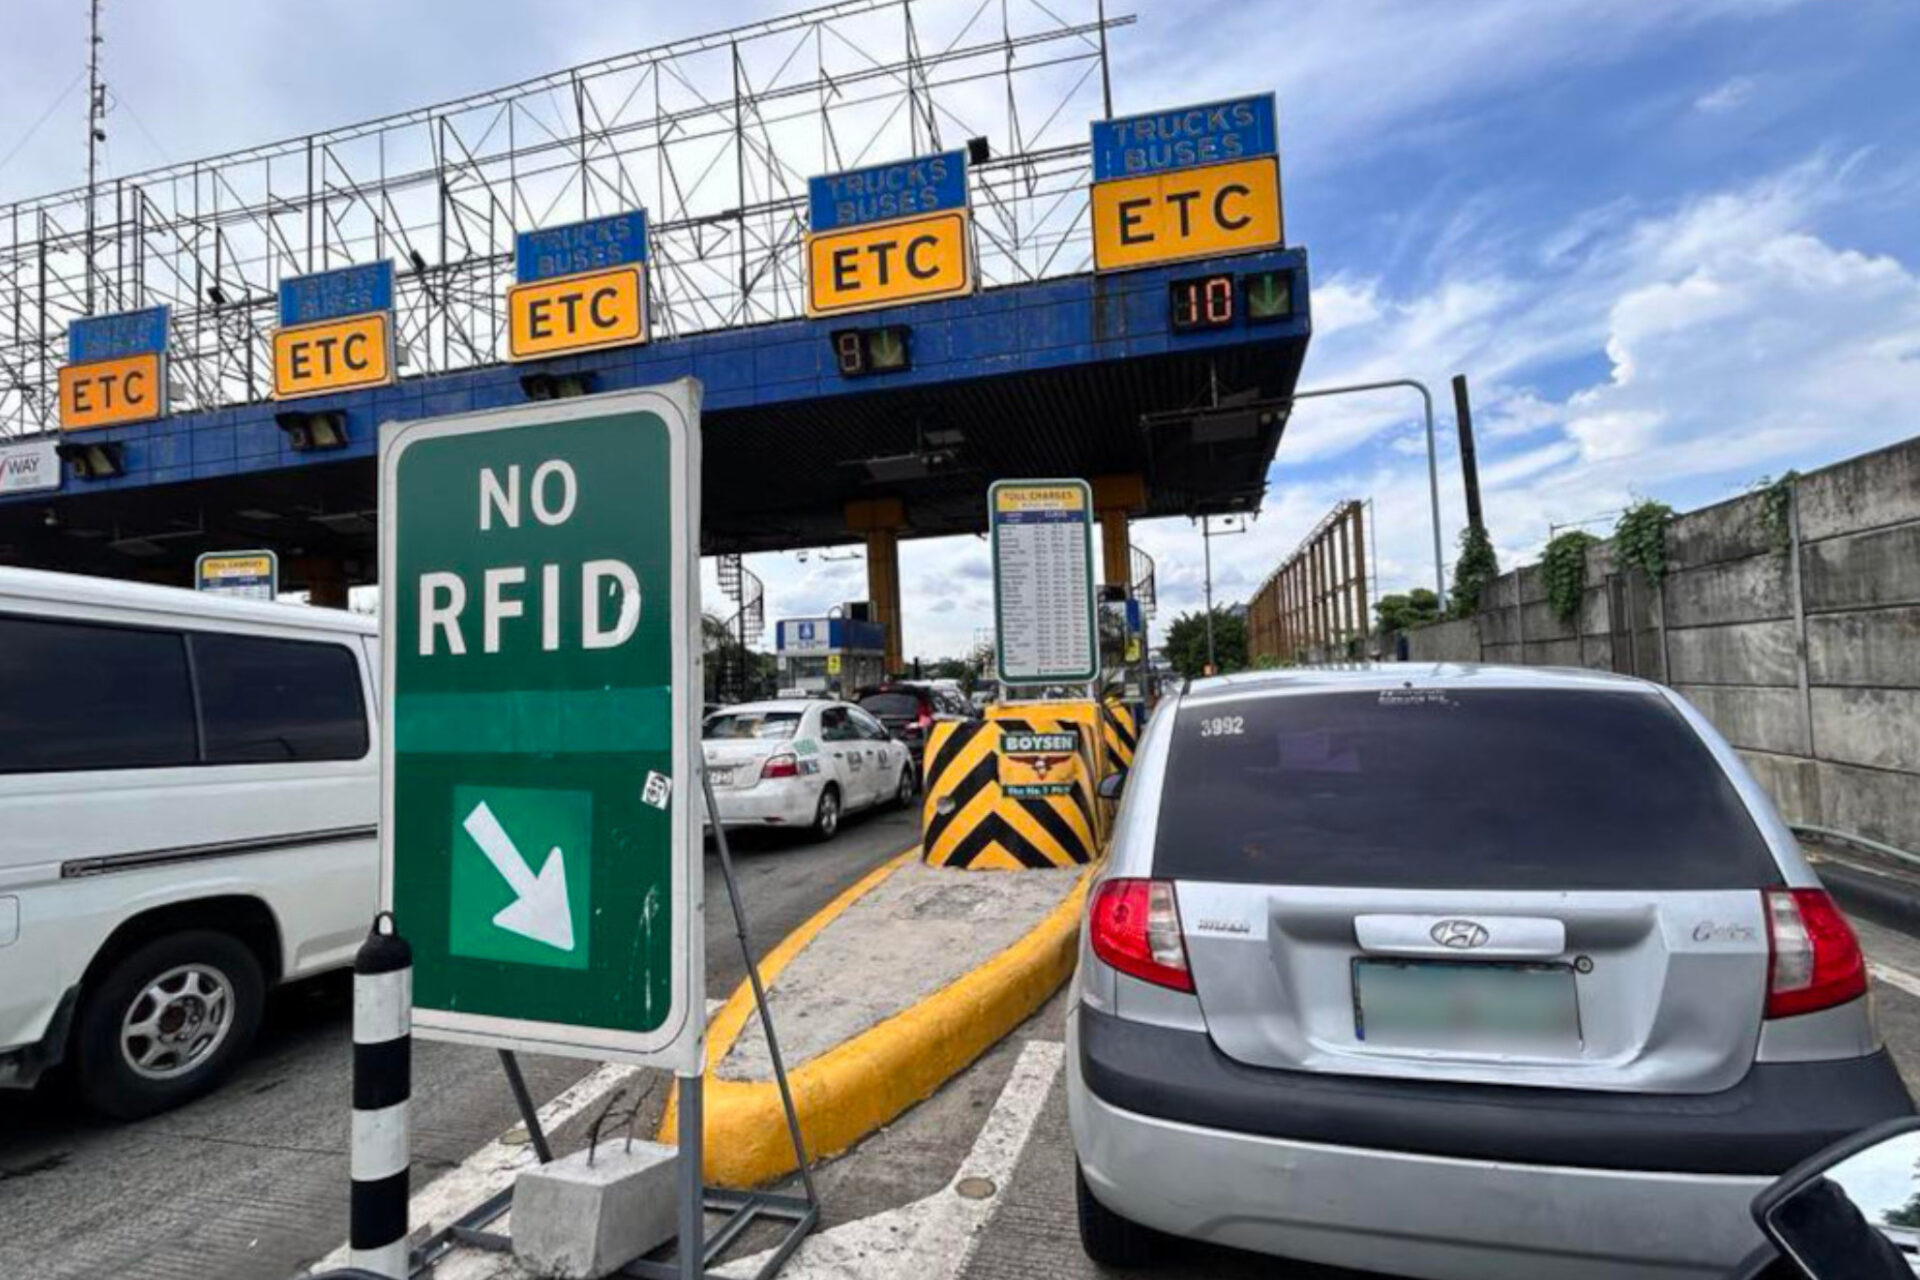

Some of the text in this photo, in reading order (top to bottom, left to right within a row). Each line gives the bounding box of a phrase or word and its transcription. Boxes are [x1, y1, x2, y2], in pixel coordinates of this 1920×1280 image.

[1112, 102, 1254, 147] TRUCKS
[1123, 132, 1244, 173] BUSES
[827, 158, 948, 199] TRUCKS
[836, 185, 939, 226] BUSES
[1118, 184, 1252, 246] ETC
[833, 235, 941, 292] ETC
[529, 287, 619, 340] ETC
[1189, 277, 1232, 323] 10
[290, 332, 369, 380] ETC
[73, 371, 144, 413] ETC
[479, 459, 578, 530] NO
[418, 558, 642, 656] RFID
[1005, 736, 1073, 751] BOYSEN
[1201, 716, 1245, 738] 3992
